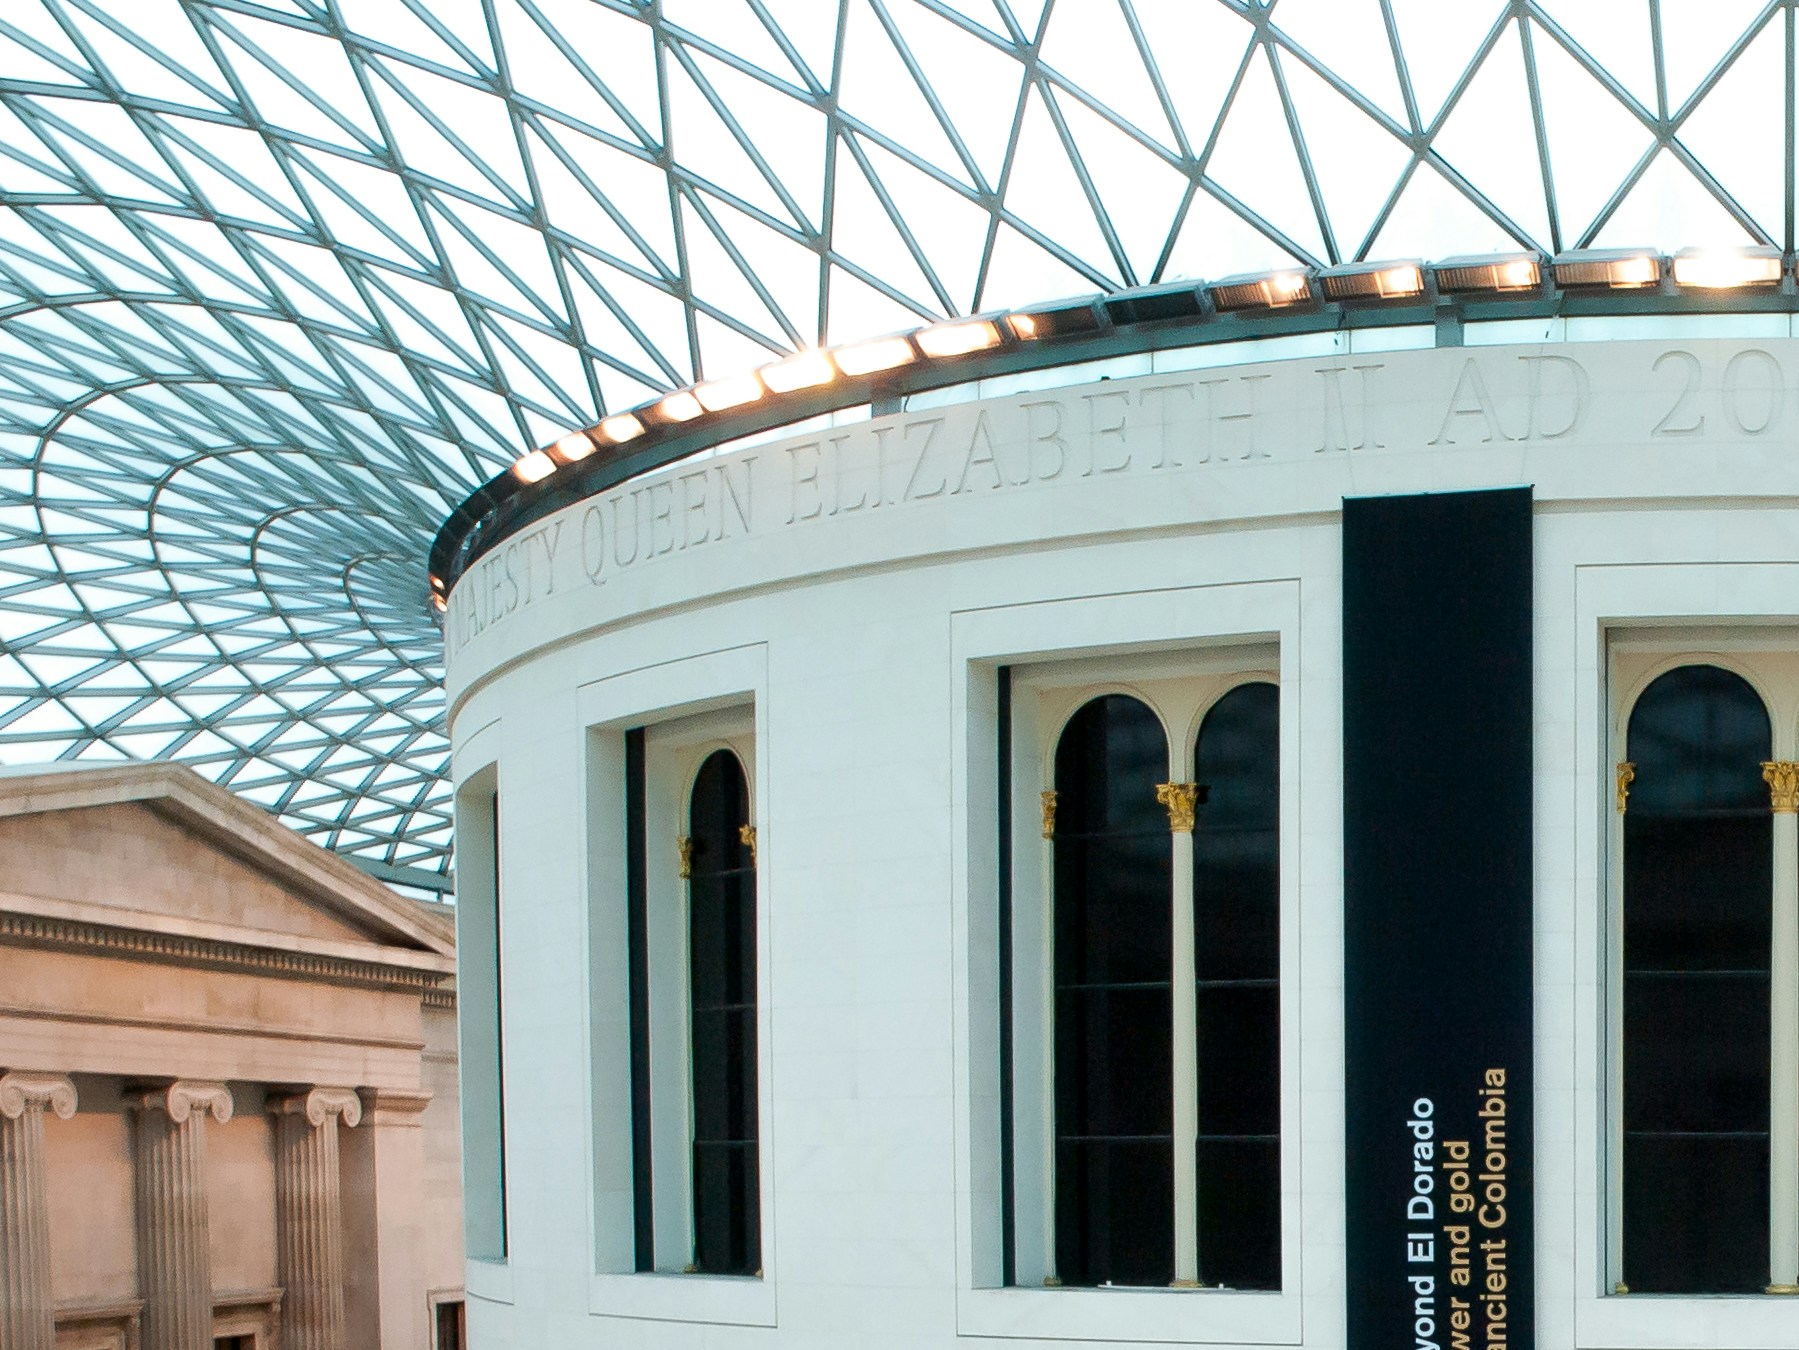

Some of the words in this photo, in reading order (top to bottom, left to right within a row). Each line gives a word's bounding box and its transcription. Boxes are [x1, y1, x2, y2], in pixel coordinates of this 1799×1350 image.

[584, 458, 755, 586] QUEEN
[785, 373, 1272, 524] ELIZABETH
[1313, 363, 1385, 453] II
[1427, 354, 1592, 445] AD
[1407, 1098, 1434, 1219] Dorado
[1443, 1141, 1475, 1212] gold
[1479, 1069, 1506, 1228] Colombia
[1408, 1233, 1434, 1262] El
[1444, 1226, 1470, 1285] and
